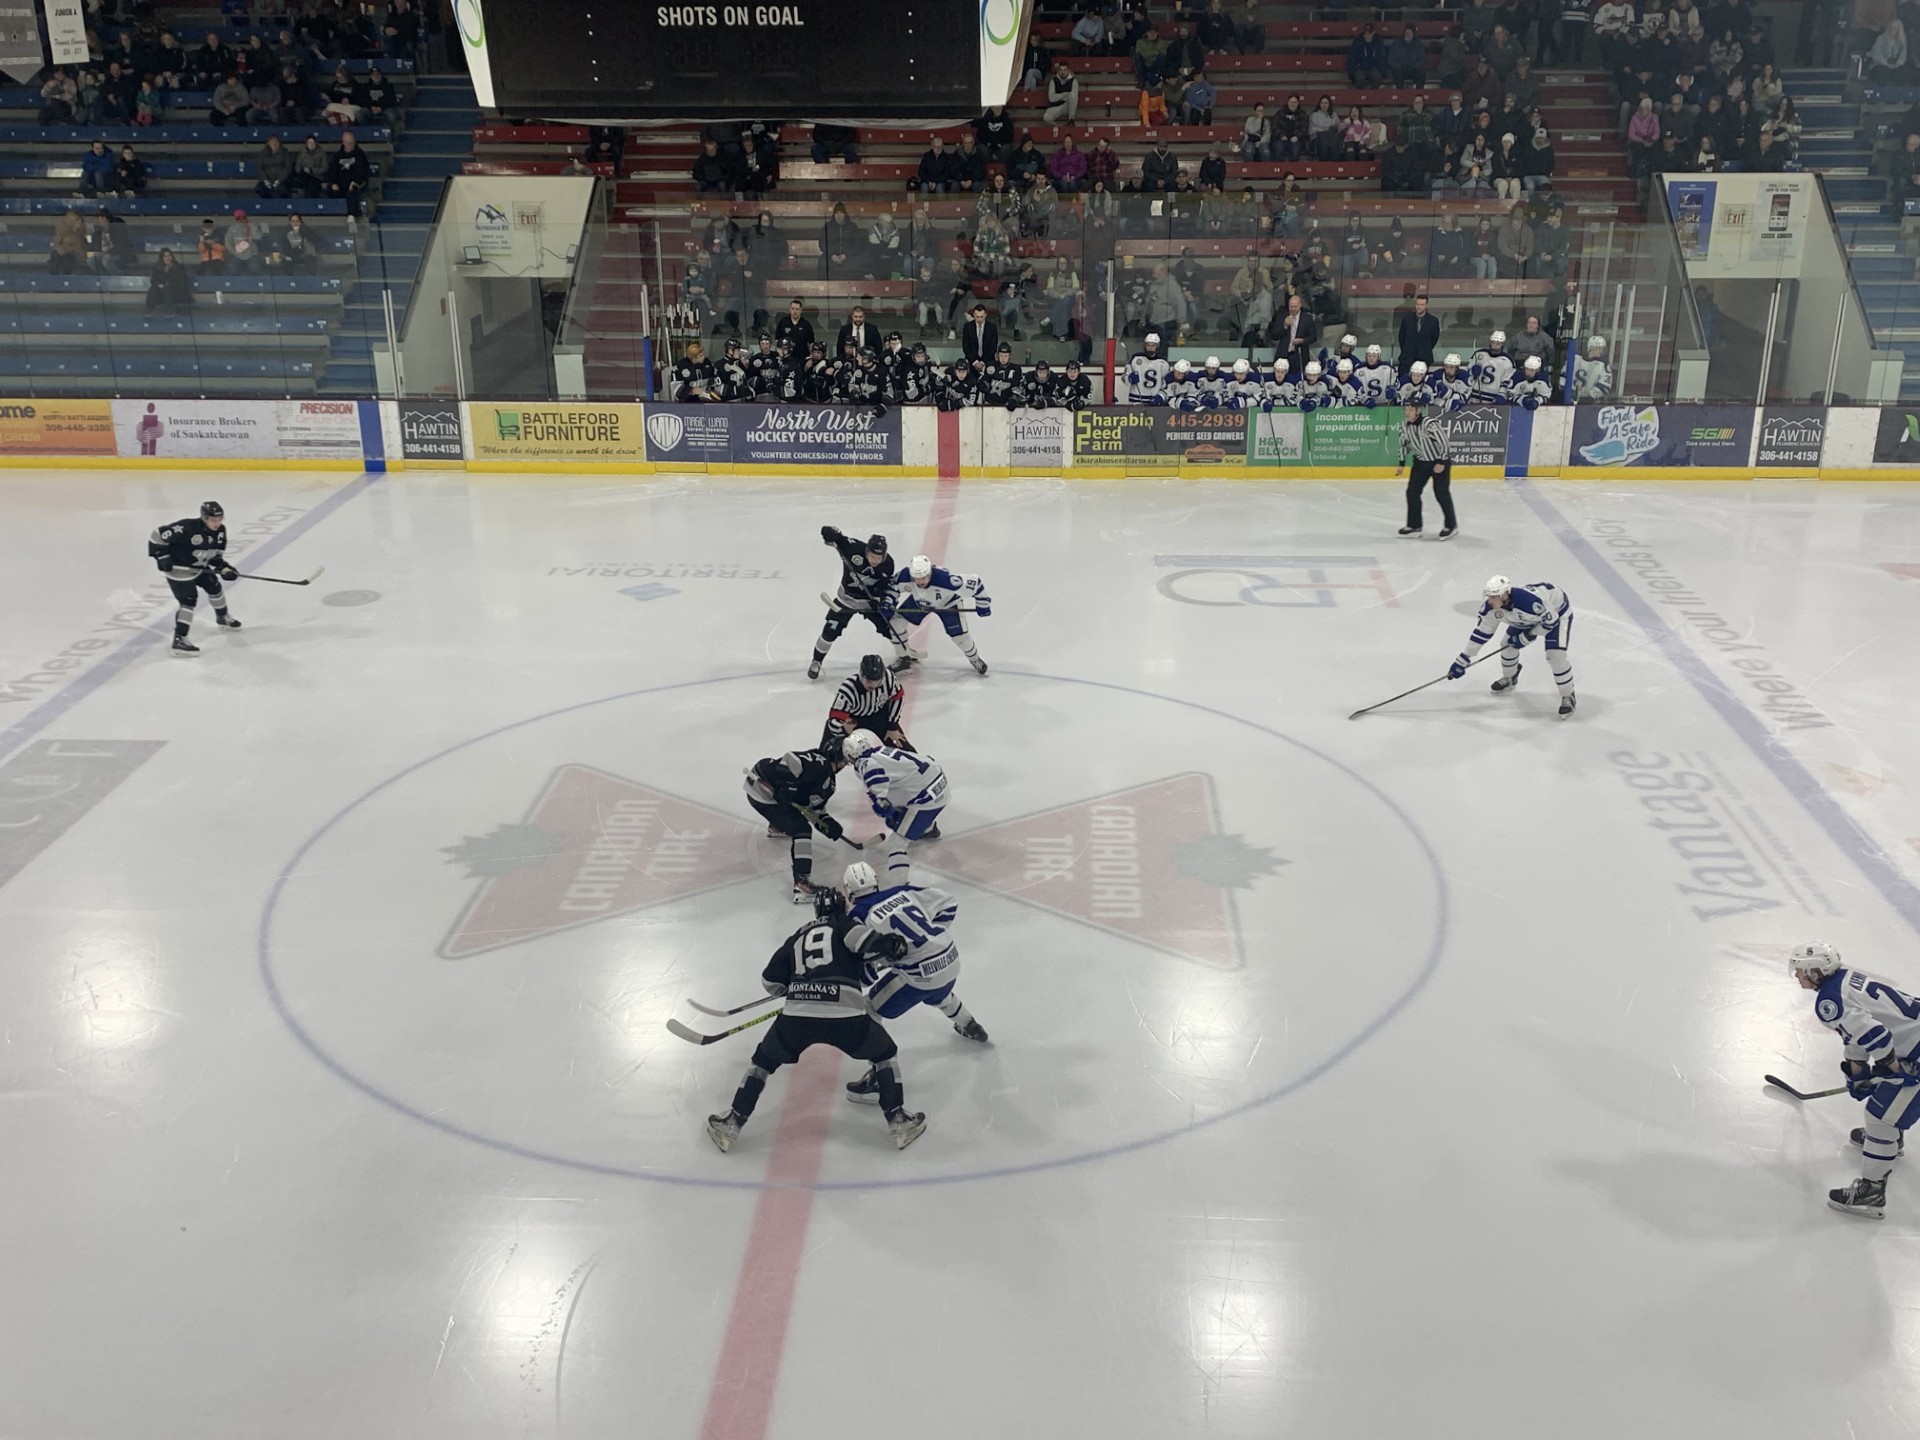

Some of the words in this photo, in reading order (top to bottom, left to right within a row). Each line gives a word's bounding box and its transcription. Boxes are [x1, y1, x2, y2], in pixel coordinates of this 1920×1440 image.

[657, 6, 718, 26] SHOTS
[723, 6, 749, 26] ON
[755, 6, 804, 26] GOAL
[520, 214, 537, 225] EXIT
[1726, 213, 1746, 225] EXIT
[1143, 369, 1158, 389] S
[1481, 366, 1496, 385] S
[1367, 379, 1382, 397] S
[300, 402, 353, 414] PRECISION
[168, 417, 216, 426] Insurance
[218, 417, 257, 426] Brokers
[522, 412, 620, 425] BATTLEFORD
[683, 416, 706, 427] MAGIC
[708, 417, 729, 428] WAND
[756, 408, 821, 431] North
[818, 408, 877, 431] West
[1166, 413, 1245, 428] 445-2939
[1315, 413, 1353, 422] Income
[1354, 413, 1370, 422] tax
[1601, 408, 1631, 425] Find
[170, 430, 180, 439] of
[182, 430, 250, 439] Saskatchewan
[404, 421, 459, 440] HAWTIN
[523, 425, 621, 442] FURNITURE
[1014, 425, 1060, 440] HAWTIN
[1315, 422, 1373, 433] preparation
[1439, 420, 1500, 438] HAWTIN
[1610, 425, 1619, 439] A
[1620, 423, 1652, 437] Safe
[746, 431, 797, 443] HOCKEY
[799, 431, 889, 444] DEVELOPMENT
[1166, 431, 1195, 441] PEDIGREE
[1196, 431, 1212, 441] SEED
[1213, 431, 1245, 441] GROWERS
[1258, 436, 1284, 446] H&R
[1626, 436, 1656, 450] Ride
[1763, 428, 1822, 447] HAWTIN
[404, 443, 461, 454] 306-441-4158
[510, 446, 523, 454] the
[576, 446, 599, 455] worth
[601, 446, 614, 455] the
[1012, 445, 1061, 454] 306-441-4158
[1257, 446, 1298, 457] BLOCK
[1759, 450, 1819, 461] 306-441-4158
[751, 451, 792, 459] VOLUNTEER
[793, 452, 839, 460] CONCESSION
[840, 452, 884, 461] CONVENORS
[965, 579, 977, 591] 19
[935, 592, 942, 600] A
[1607, 750, 1785, 922] Vantage
[557, 799, 663, 912] CANADIAN
[1089, 804, 1144, 919] CANADIAN
[873, 893, 911, 920] IYOGUN
[793, 925, 834, 976] 19
[921, 956, 948, 977] MELVILLE
[788, 981, 838, 995] MONTANA'S
